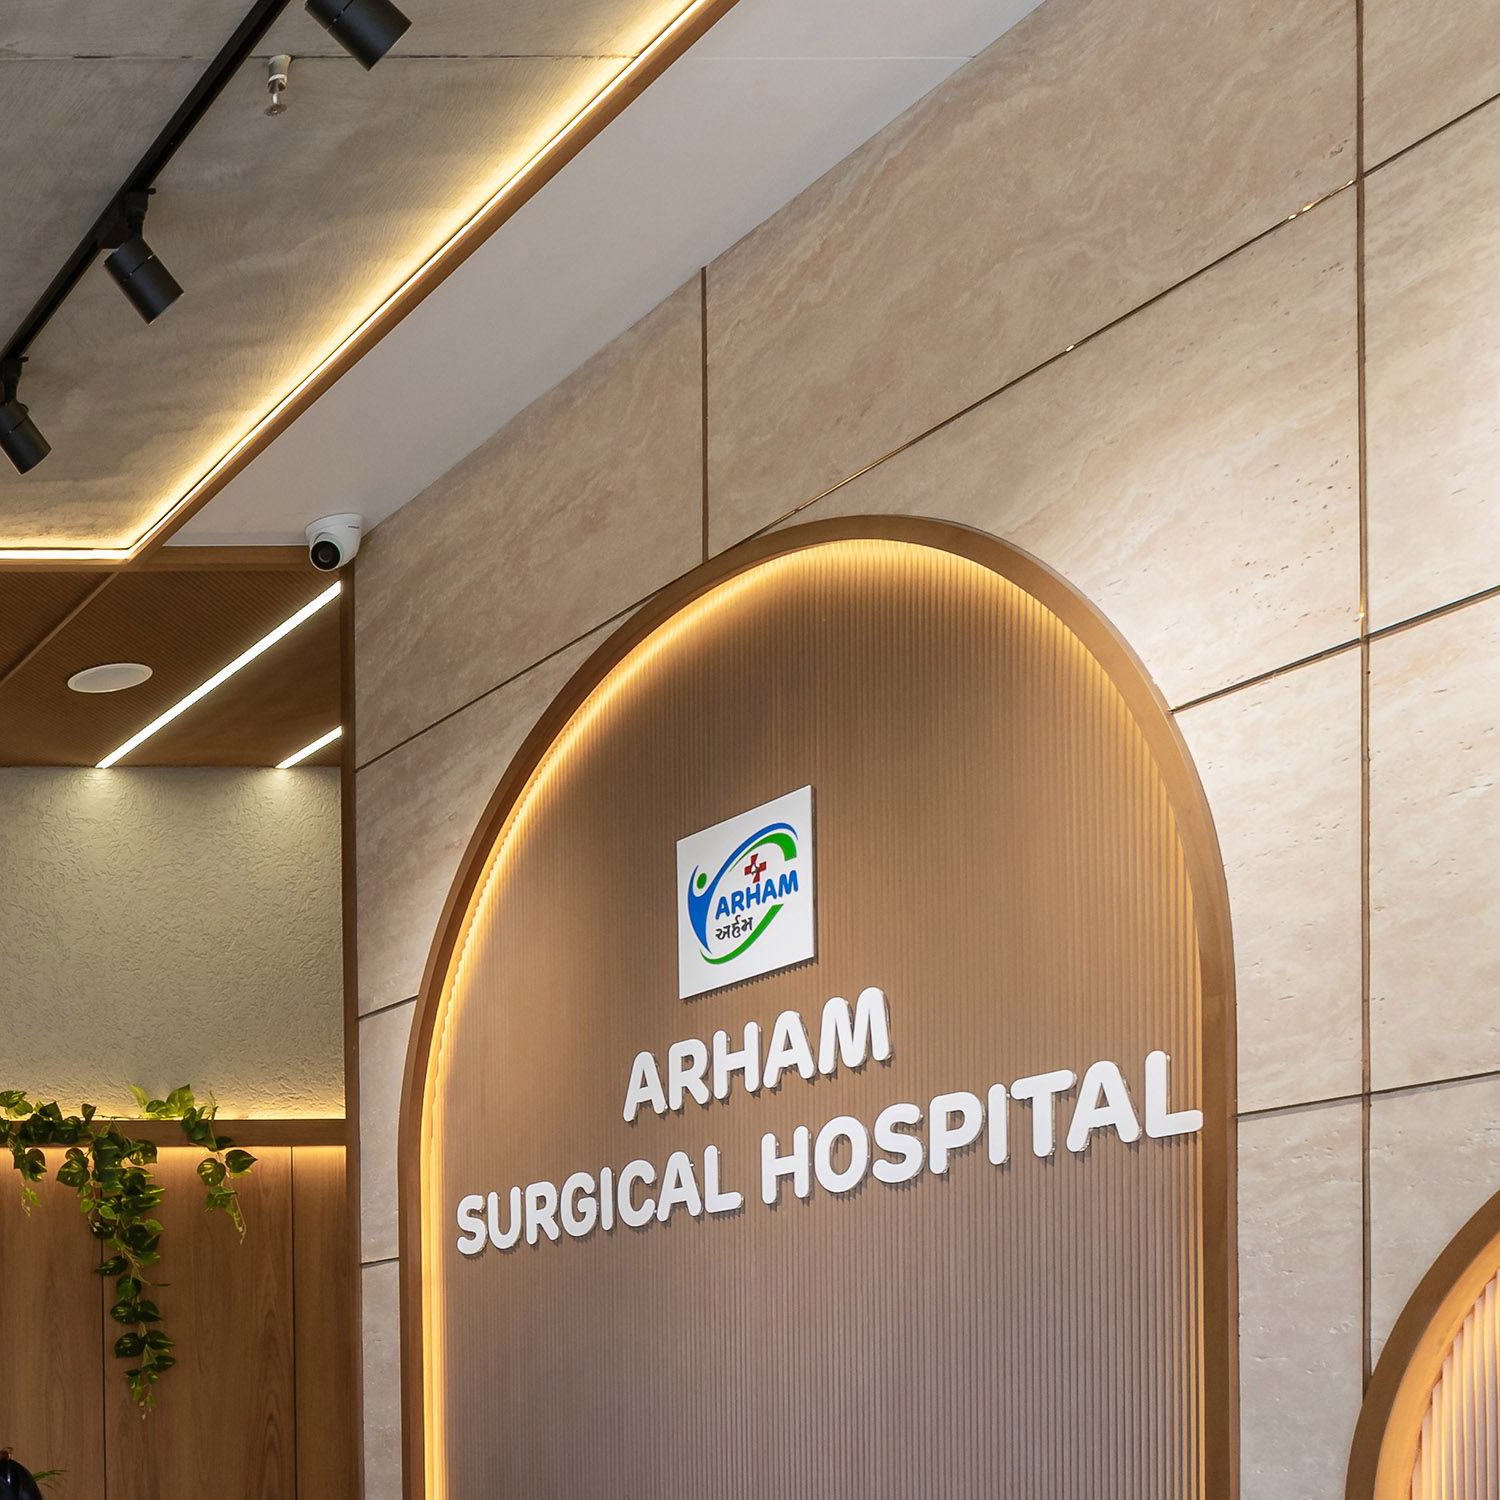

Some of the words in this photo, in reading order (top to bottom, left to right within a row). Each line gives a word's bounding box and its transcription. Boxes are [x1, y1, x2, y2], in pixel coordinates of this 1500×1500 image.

[715, 869, 799, 921] ARHAM
[715, 914, 754, 941] અર્હમ
[622, 986, 893, 1122] ARHAM
[456, 1144, 744, 1256] SURGICAL
[760, 1050, 1205, 1206] HOSPITAL
